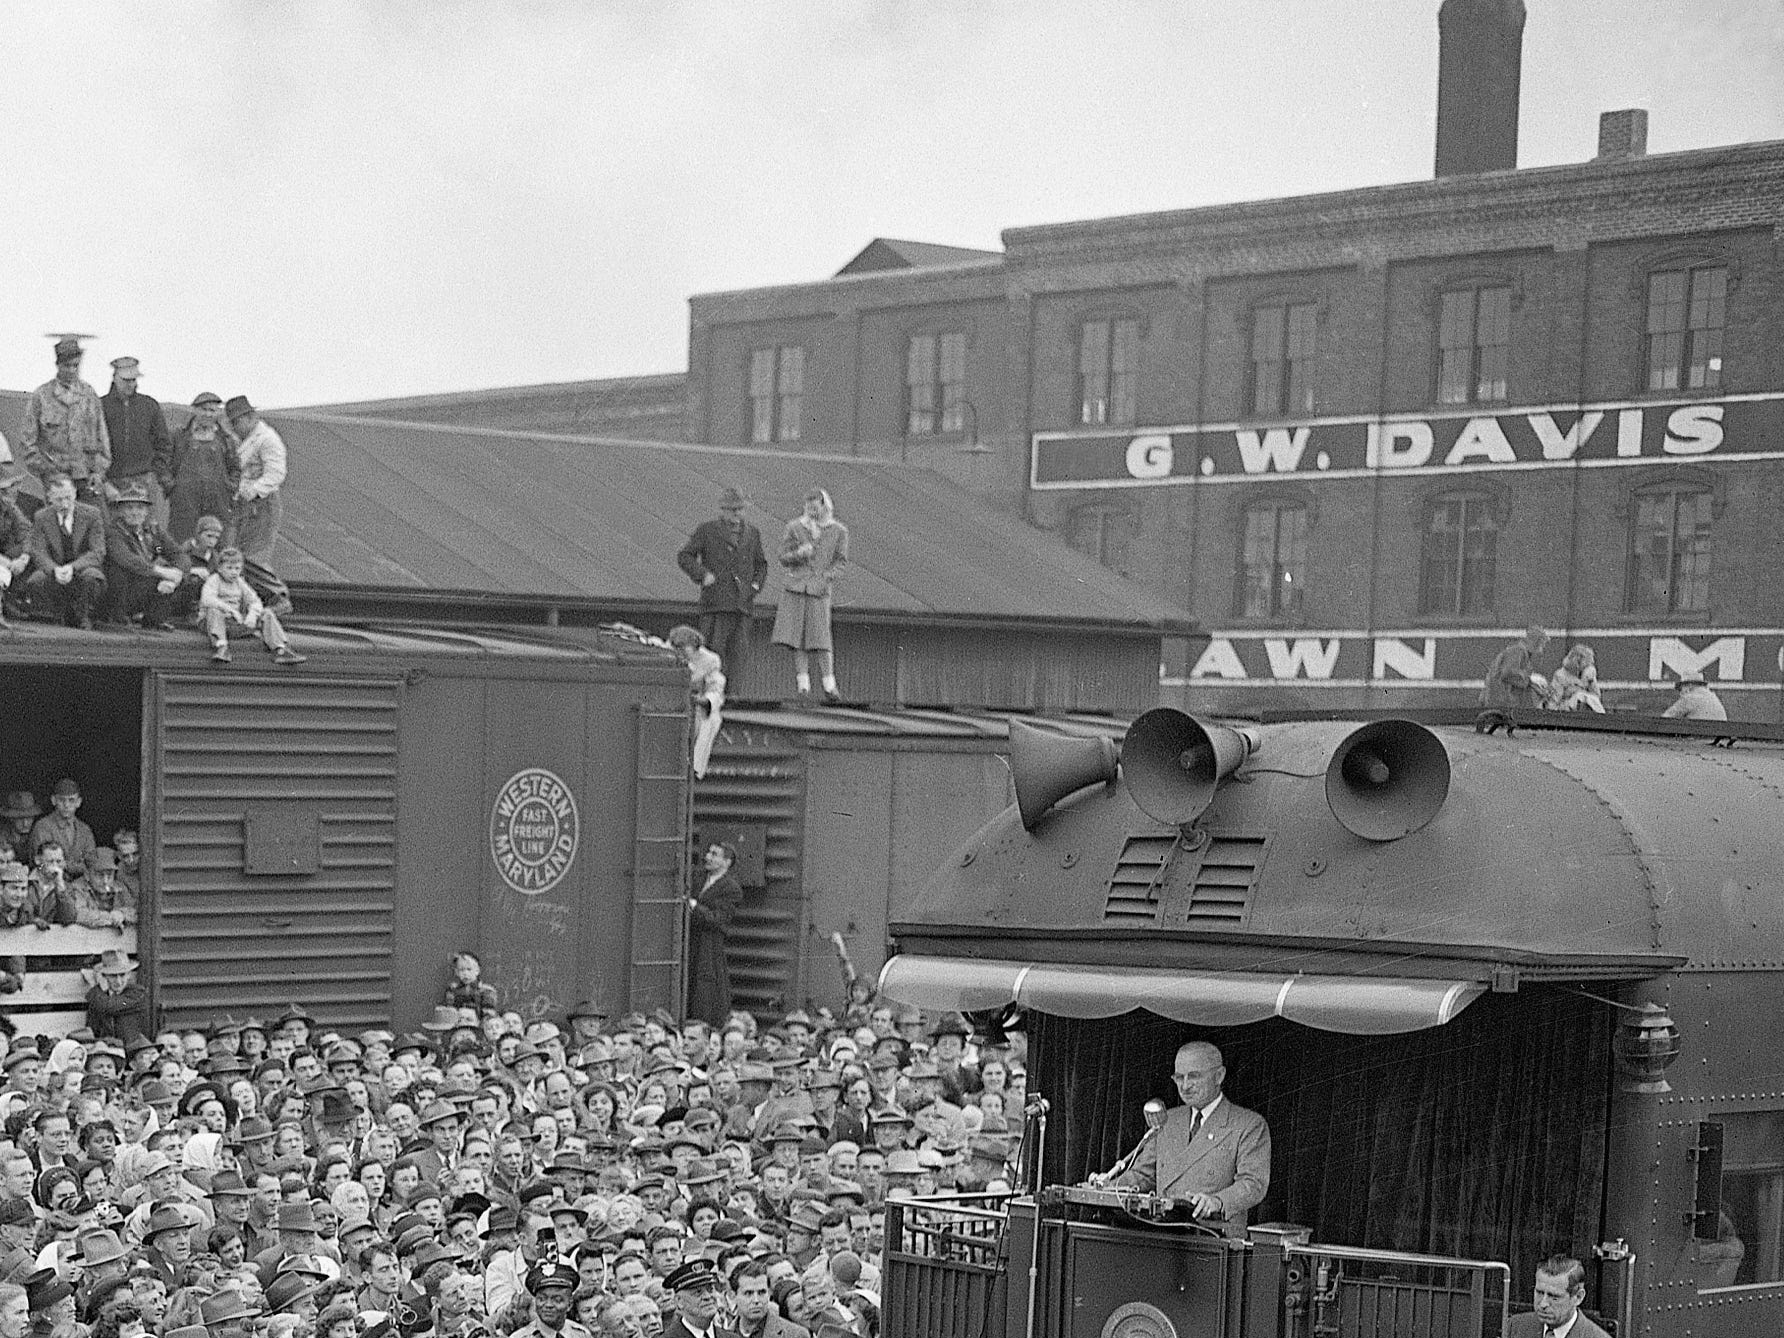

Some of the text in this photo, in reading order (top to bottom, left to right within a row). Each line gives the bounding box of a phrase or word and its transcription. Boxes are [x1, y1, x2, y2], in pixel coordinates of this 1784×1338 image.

[1366, 403, 1726, 469] DAVIS
[1159, 634, 1784, 682] AWN M
[498, 775, 572, 820] WESTERN
[521, 808, 548, 822] FAST
[514, 824, 555, 839] FREIGHT
[521, 841, 545, 854] LINE
[495, 834, 573, 888] MARYLAND
